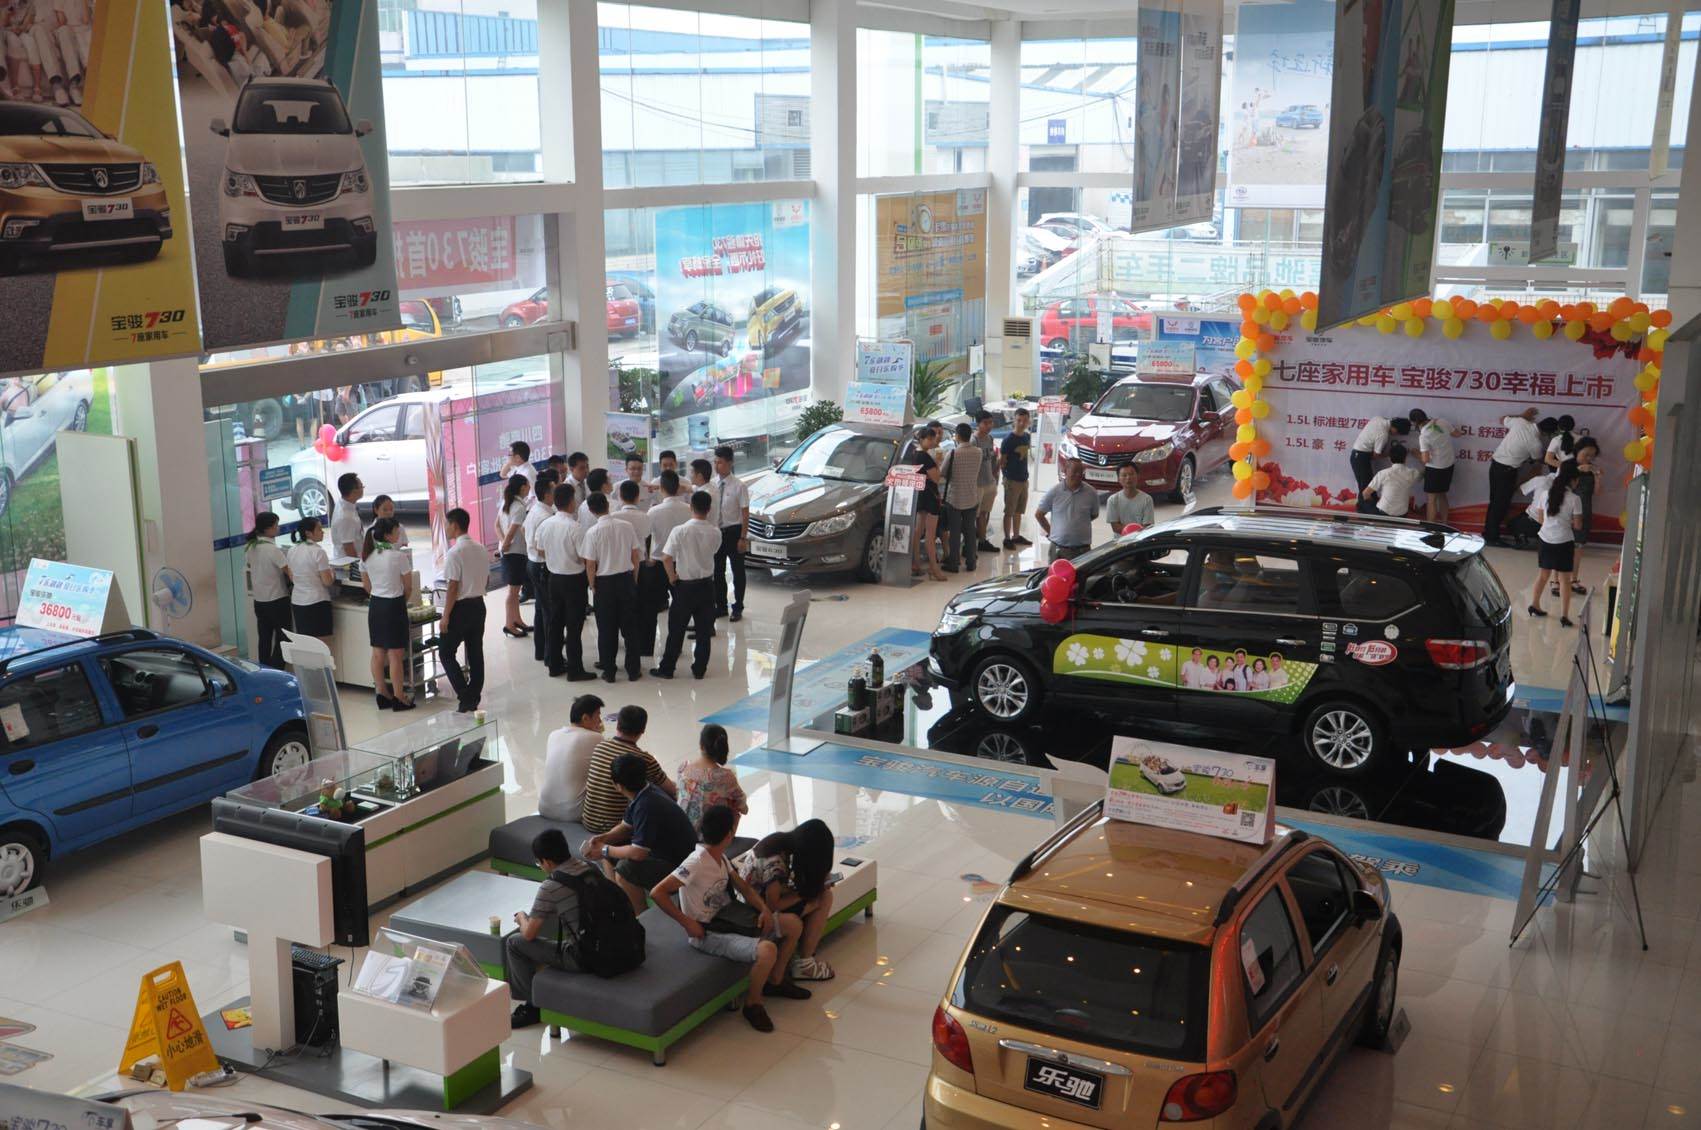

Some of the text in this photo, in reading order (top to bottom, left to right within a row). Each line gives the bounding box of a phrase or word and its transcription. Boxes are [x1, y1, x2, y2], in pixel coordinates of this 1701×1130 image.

[334, 290, 391, 309] 宝骏730
[111, 310, 185, 330] 宝骏730
[1273, 360, 1614, 399] 七座家用车 宝骏730幸福上市
[1287, 414, 1310, 425] 1.5L
[1478, 426, 1509, 438] 舒适
[1285, 437, 1309, 448] 1.5L
[1456, 449, 1473, 460] .8L
[40, 602, 72, 620] 36800
[157, 993, 187, 1012] WET FLOOR
[158, 987, 182, 1003] CAUTION
[166, 1030, 204, 1058] 小心地滑
[1032, 1065, 1096, 1101] 乐驰
